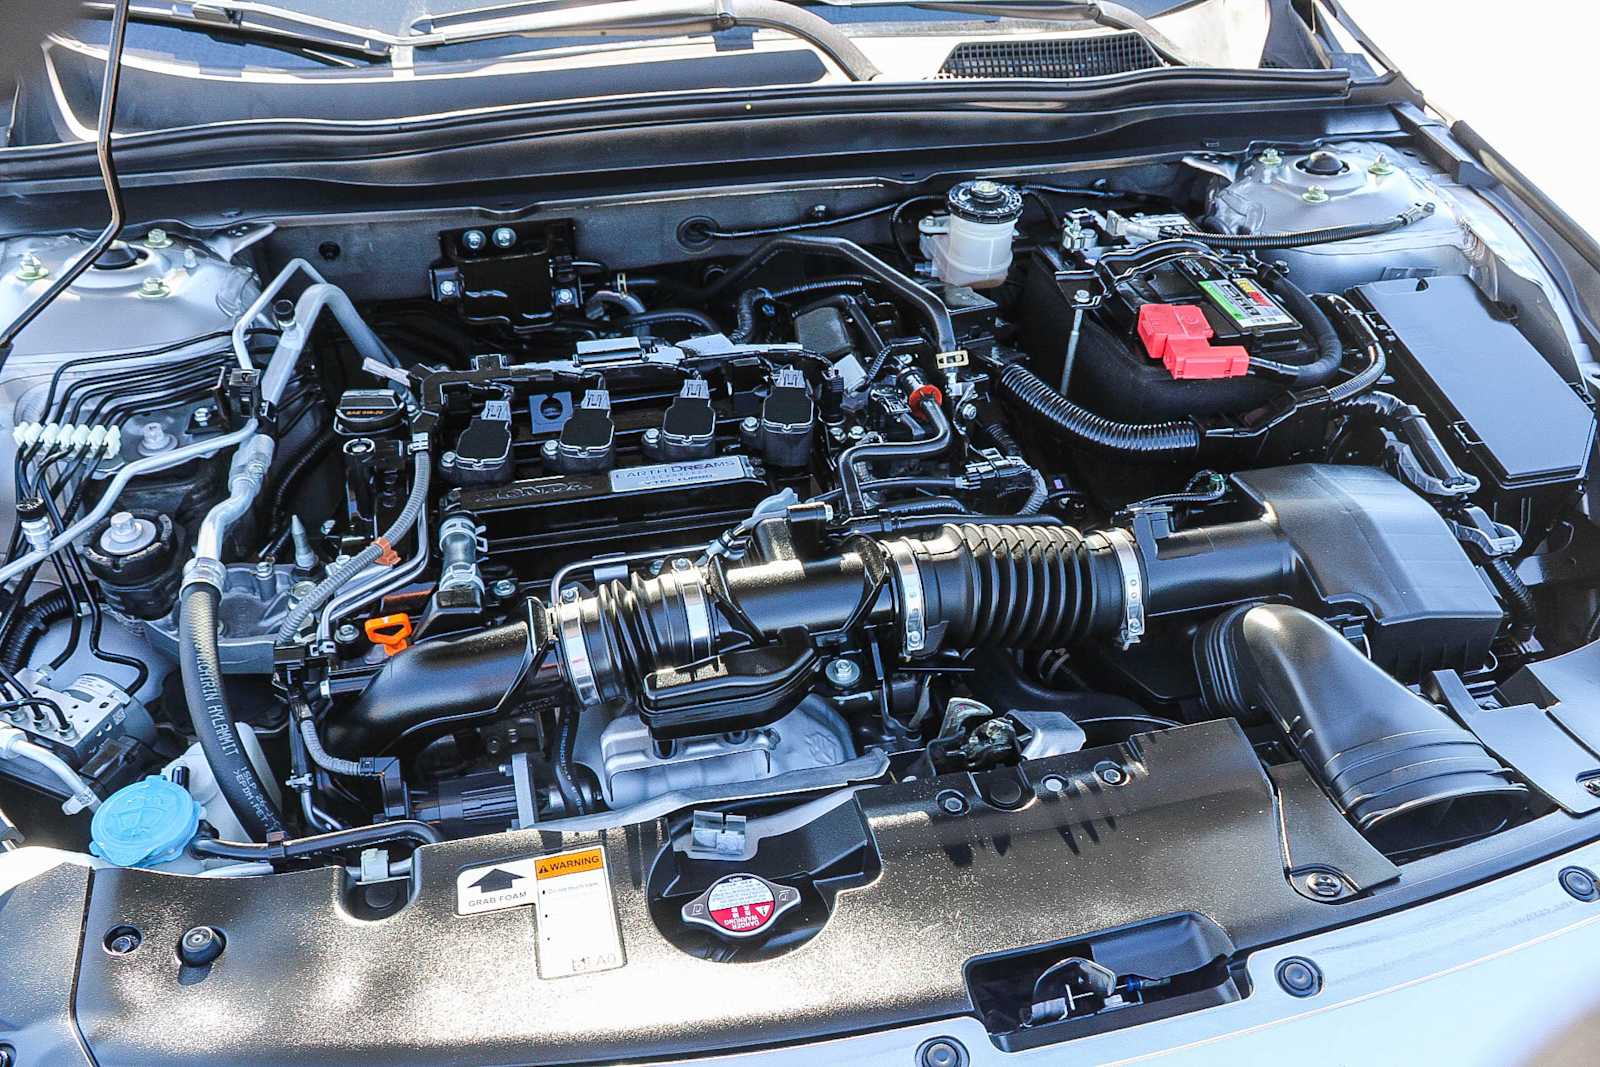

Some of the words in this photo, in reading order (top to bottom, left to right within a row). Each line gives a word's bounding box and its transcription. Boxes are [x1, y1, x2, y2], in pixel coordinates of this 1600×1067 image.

[671, 460, 736, 474] DREAMS
[549, 855, 600, 871] WARNING
[499, 890, 527, 901] FOAM
